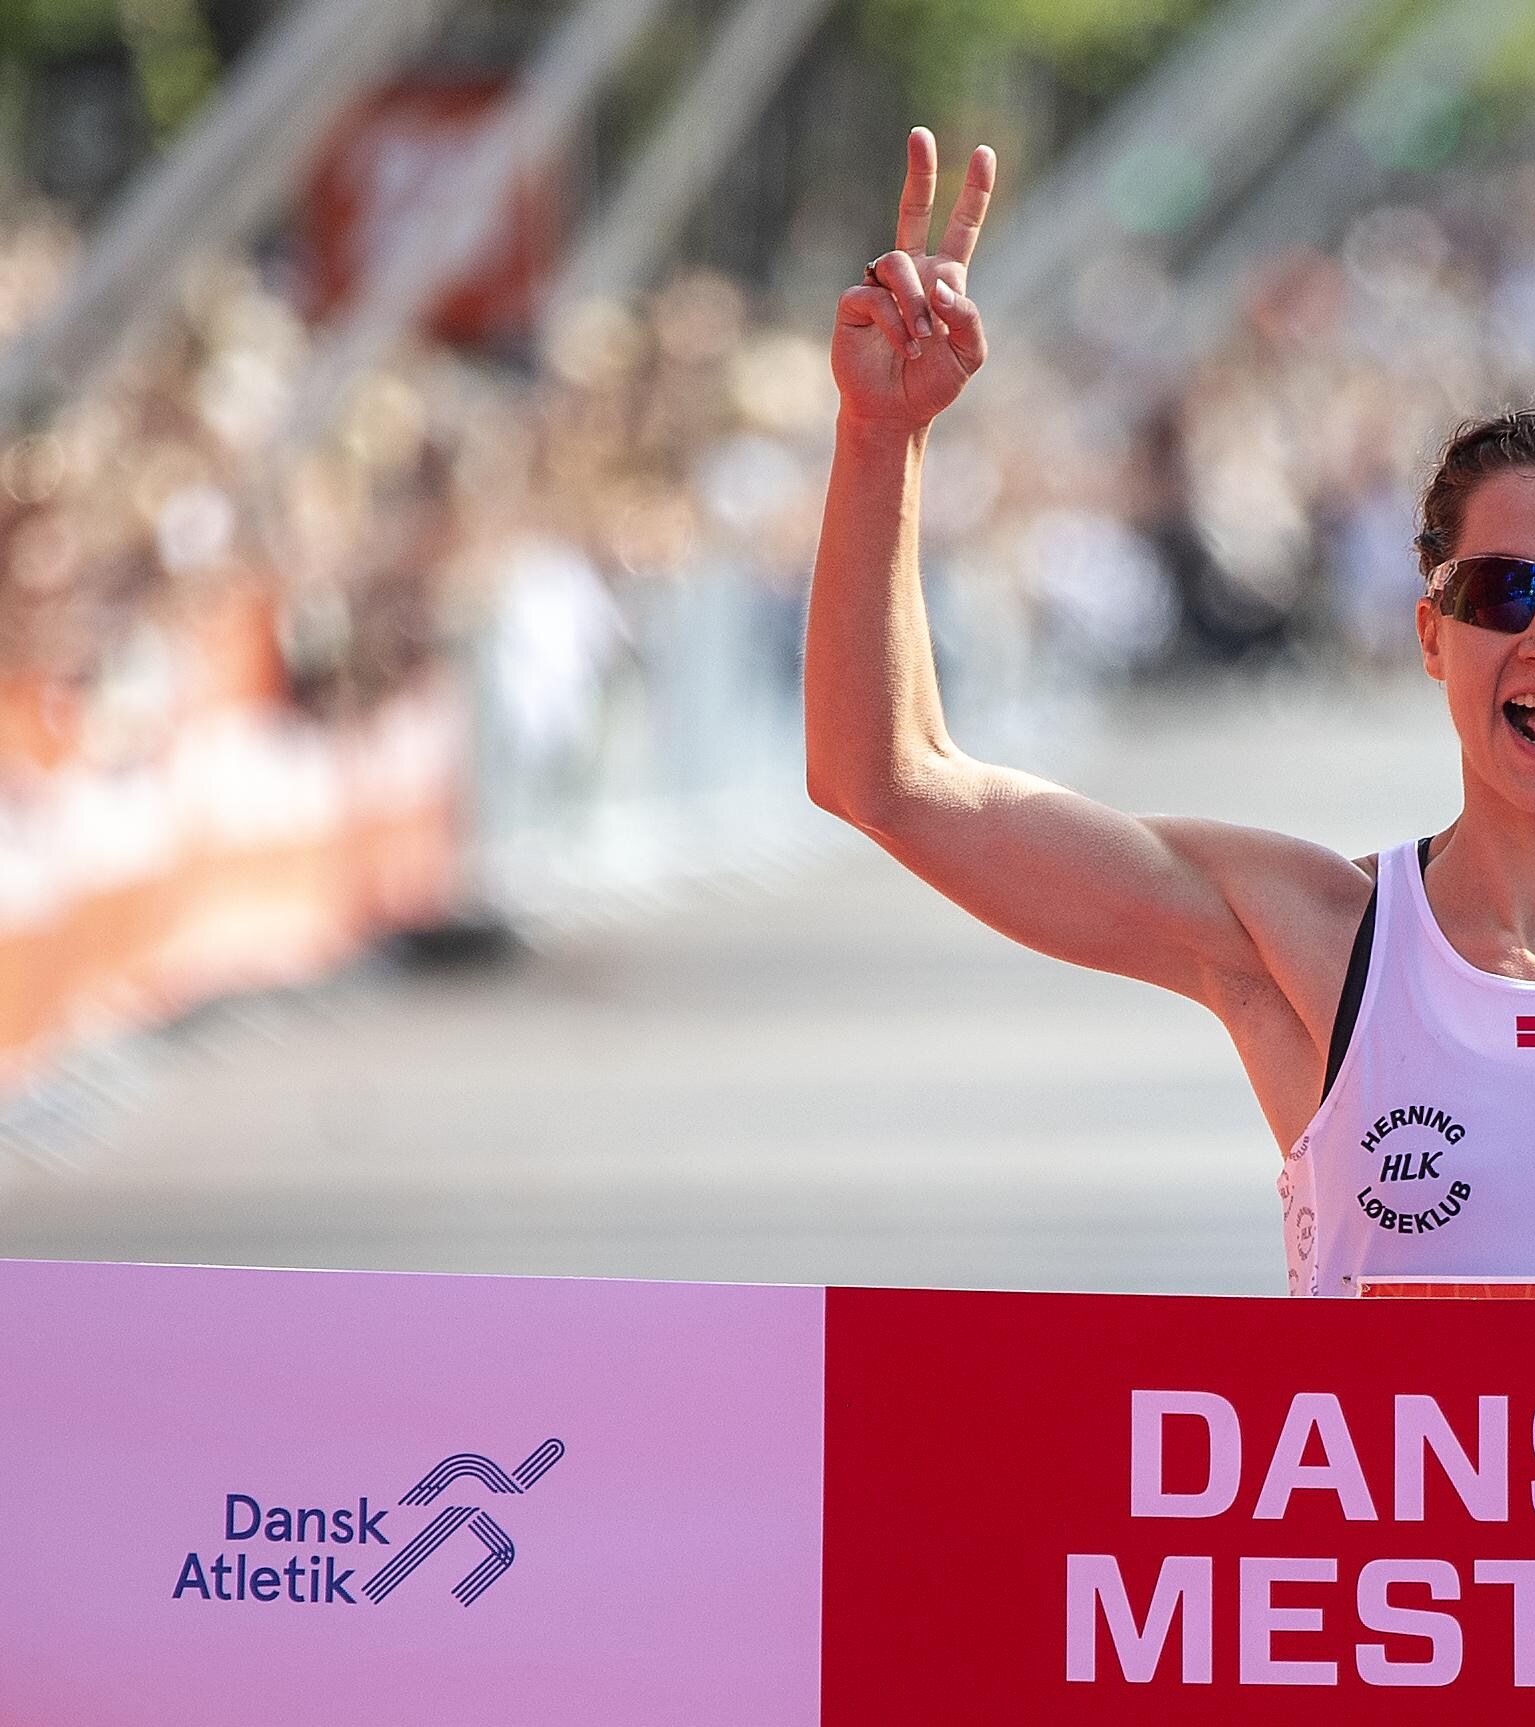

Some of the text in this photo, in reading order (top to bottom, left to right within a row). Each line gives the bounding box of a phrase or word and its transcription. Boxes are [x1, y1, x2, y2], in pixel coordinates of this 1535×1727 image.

[1360, 1105, 1466, 1154] HERNING
[1379, 1151, 1444, 1183] HLK
[1357, 1180, 1471, 1234] LØBEKLUB
[225, 1493, 390, 1545] Dansk
[171, 1552, 358, 1605] Atletik
